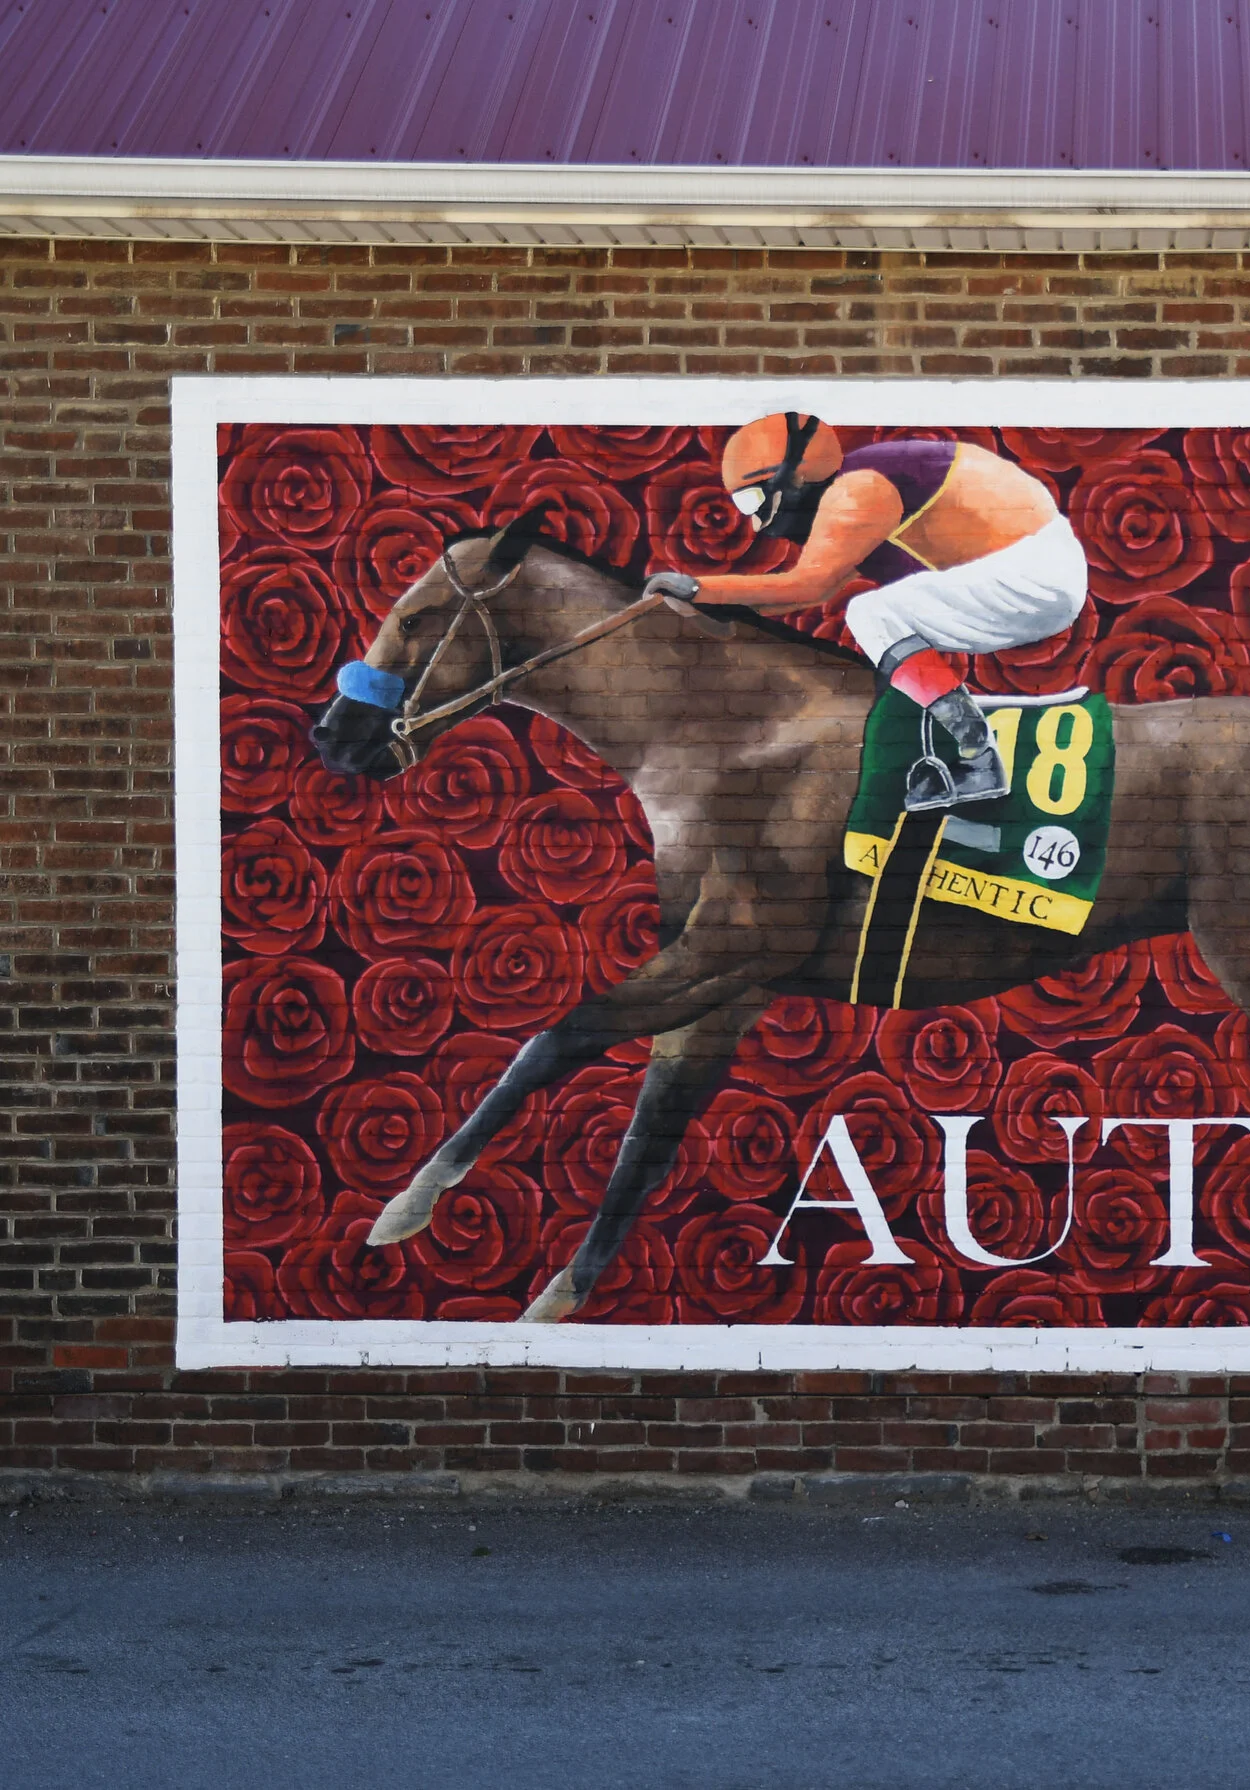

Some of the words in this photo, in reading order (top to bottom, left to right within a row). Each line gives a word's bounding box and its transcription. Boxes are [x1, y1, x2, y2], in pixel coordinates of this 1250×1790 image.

[986, 703, 1094, 816] 18
[858, 843, 1054, 921] AHENTIC
[1026, 835, 1077, 872] 146
